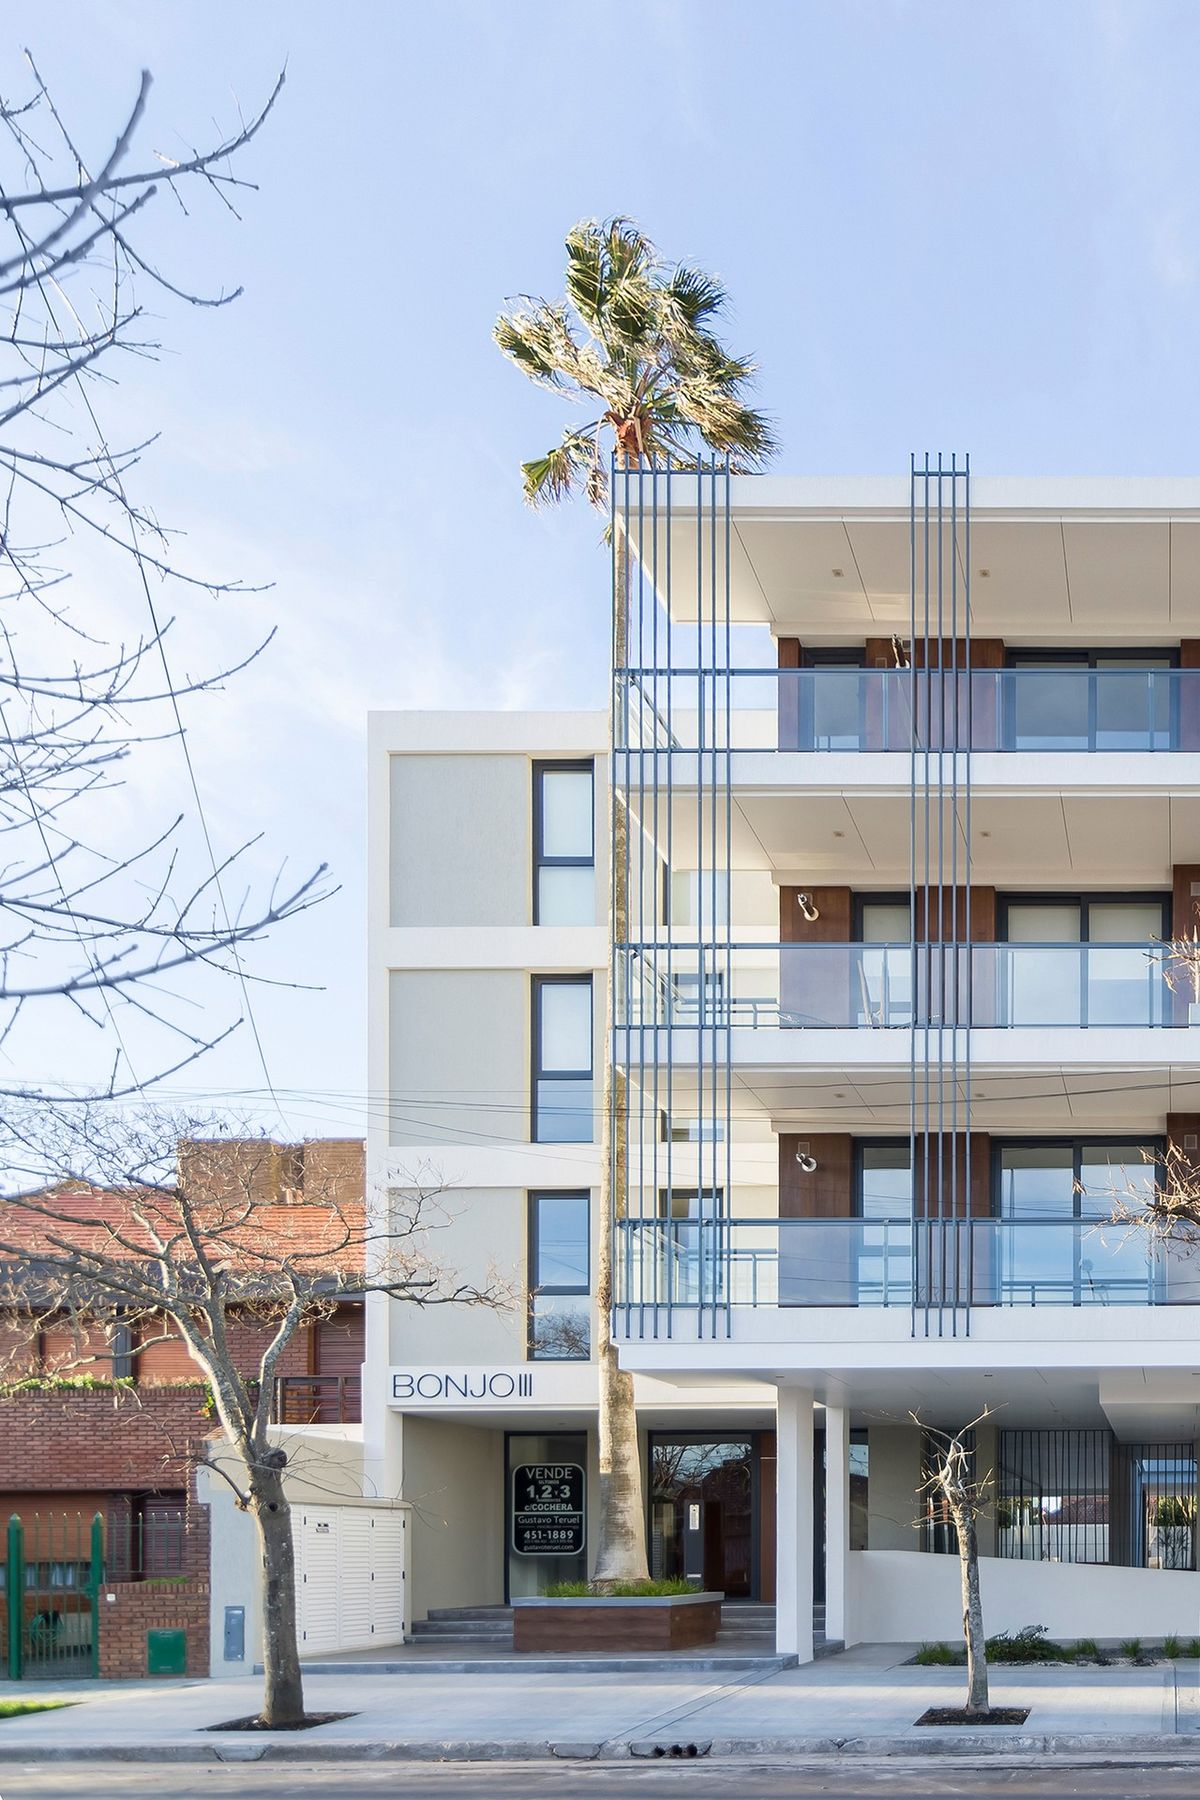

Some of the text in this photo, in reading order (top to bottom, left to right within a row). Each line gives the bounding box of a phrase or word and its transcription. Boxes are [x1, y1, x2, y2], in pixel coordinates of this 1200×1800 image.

[525, 1467, 573, 1479] VENDE
[517, 1515, 580, 1524] Gustavo Teruel
[523, 1530, 574, 1539] 451-1889
